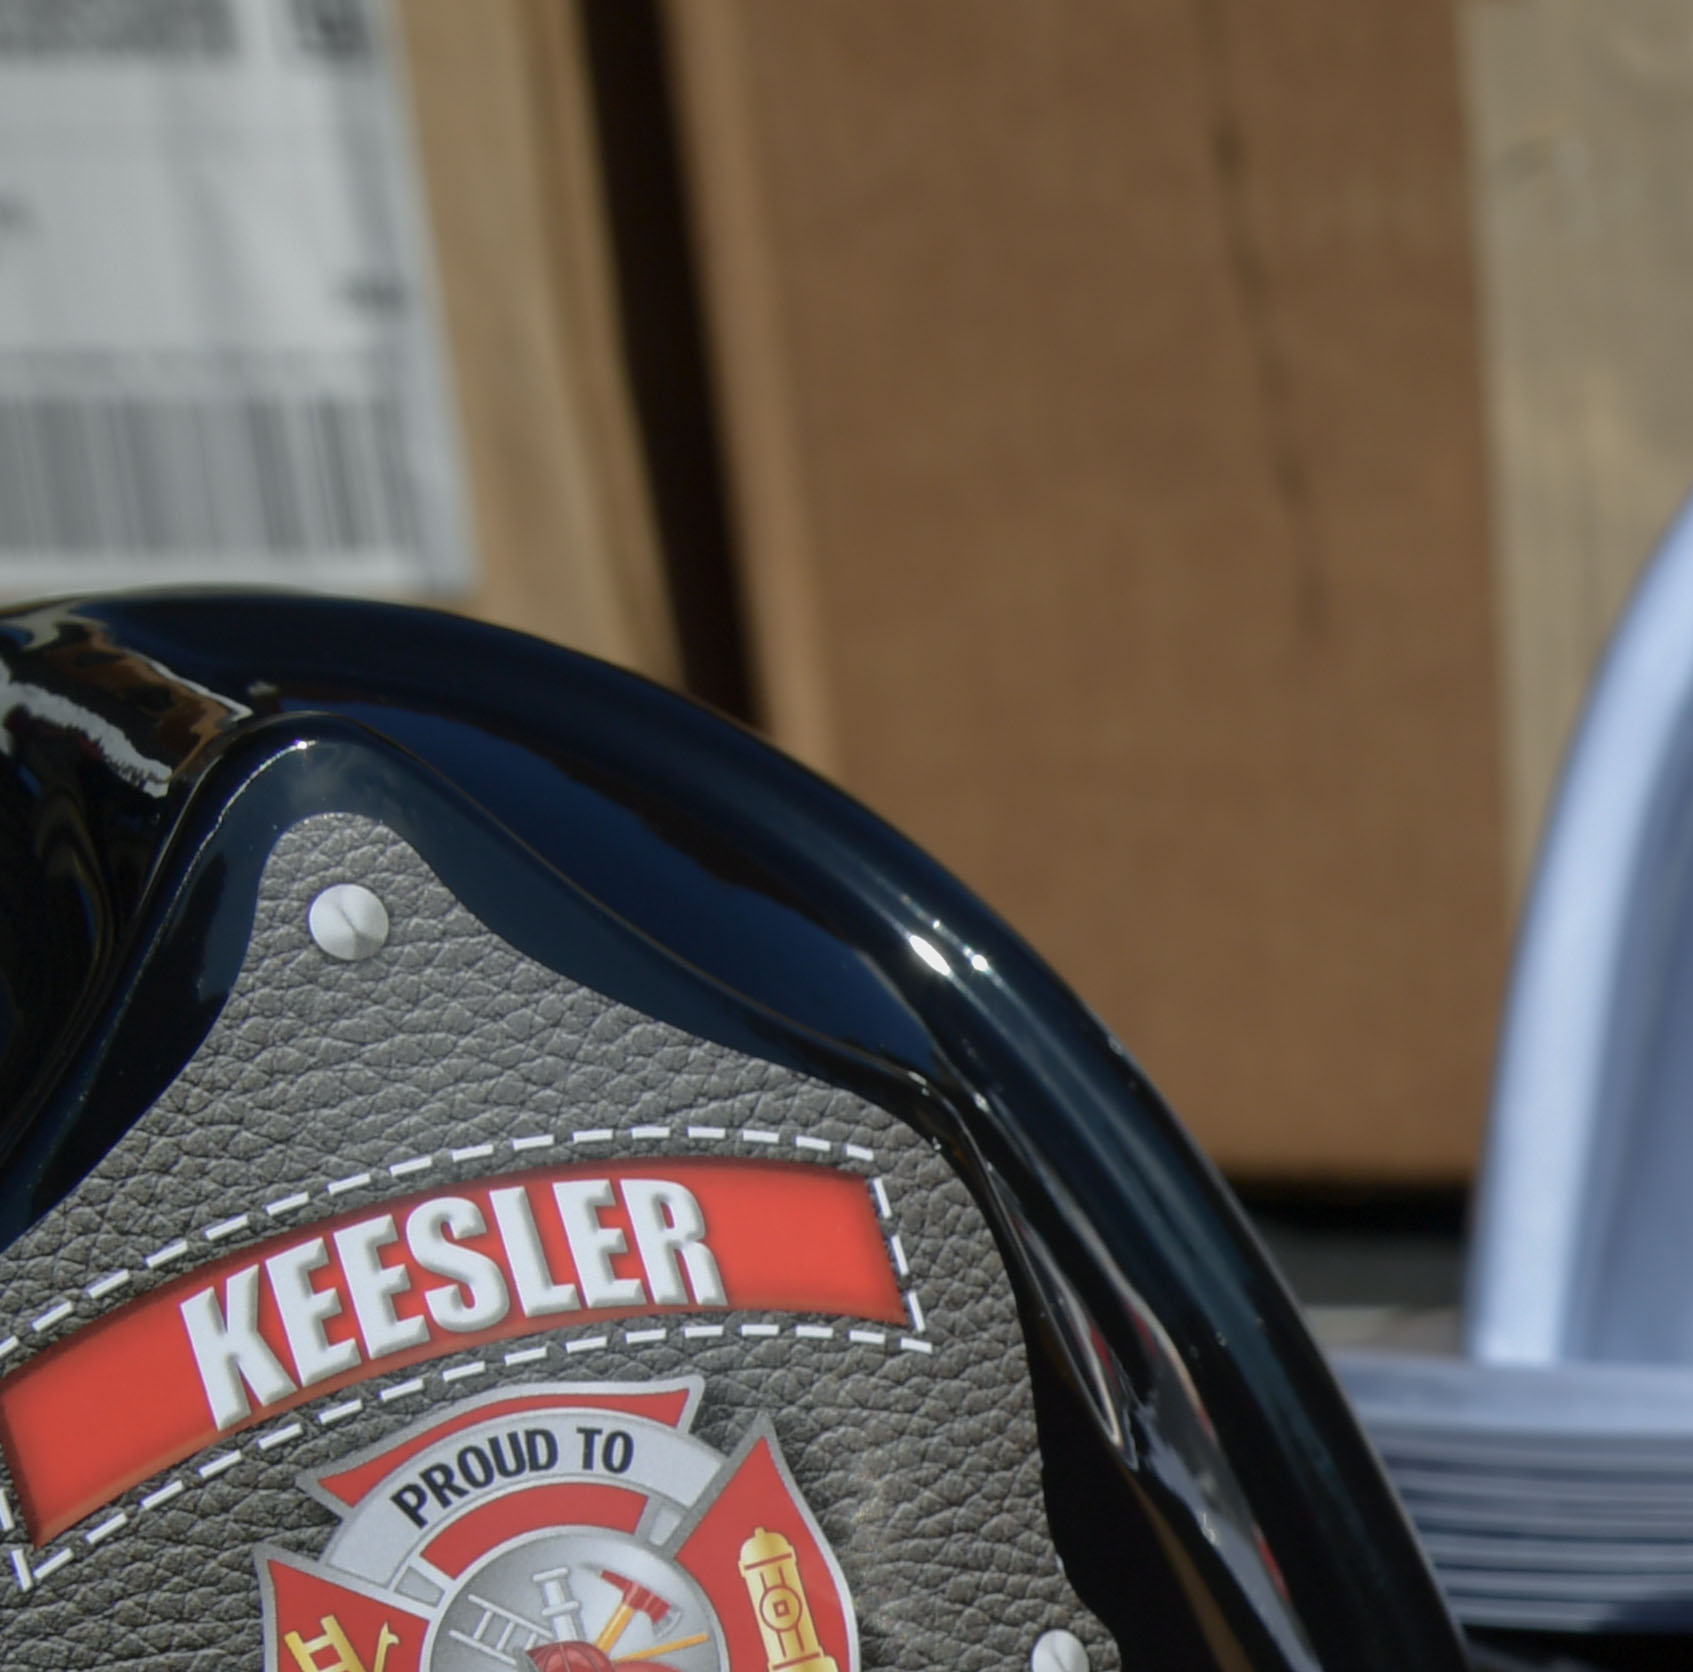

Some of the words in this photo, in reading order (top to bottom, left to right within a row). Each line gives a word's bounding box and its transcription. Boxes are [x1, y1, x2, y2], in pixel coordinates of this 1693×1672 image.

[179, 1178, 727, 1431] KEESLER
[390, 1428, 559, 1528] PROUD
[576, 1427, 635, 1476] TO
